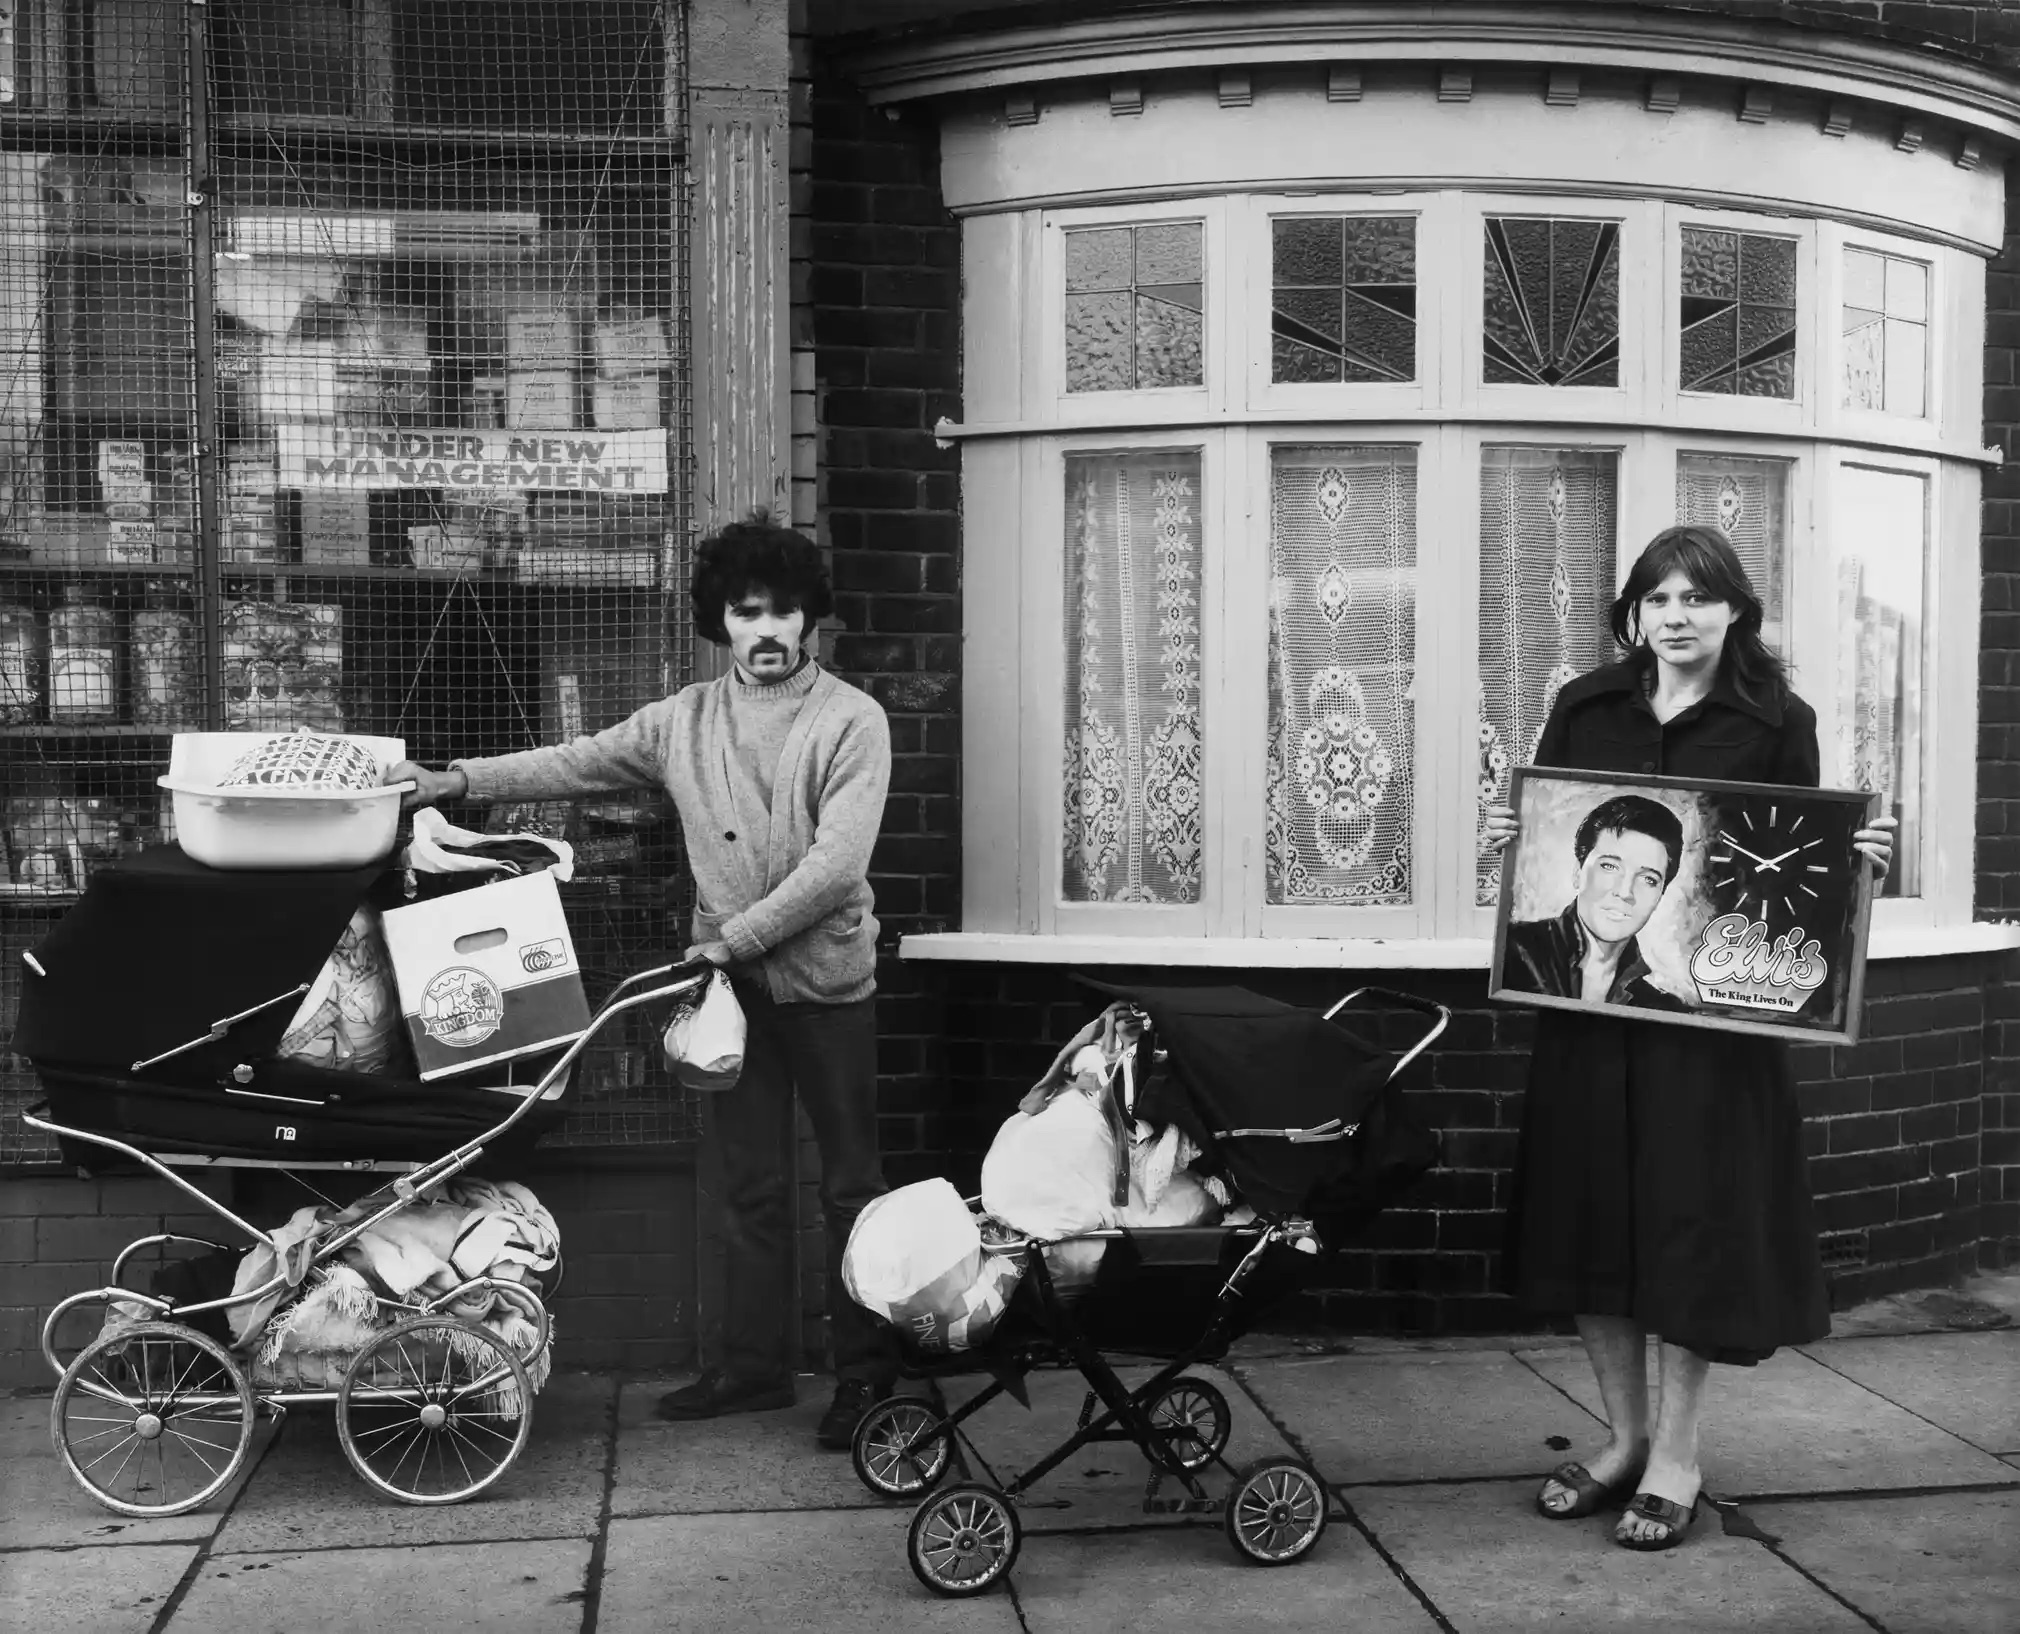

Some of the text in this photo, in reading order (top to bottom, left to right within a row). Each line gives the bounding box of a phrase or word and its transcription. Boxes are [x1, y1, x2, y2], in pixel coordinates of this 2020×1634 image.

[333, 431, 606, 464] UNDER NEW
[305, 458, 643, 489] MANAGEMENT
[1690, 913, 1827, 989] Elvis
[1708, 988, 1794, 1007] The King Lives On
[434, 1008, 497, 1034] KINGDOM
[911, 1312, 940, 1348] FINE
